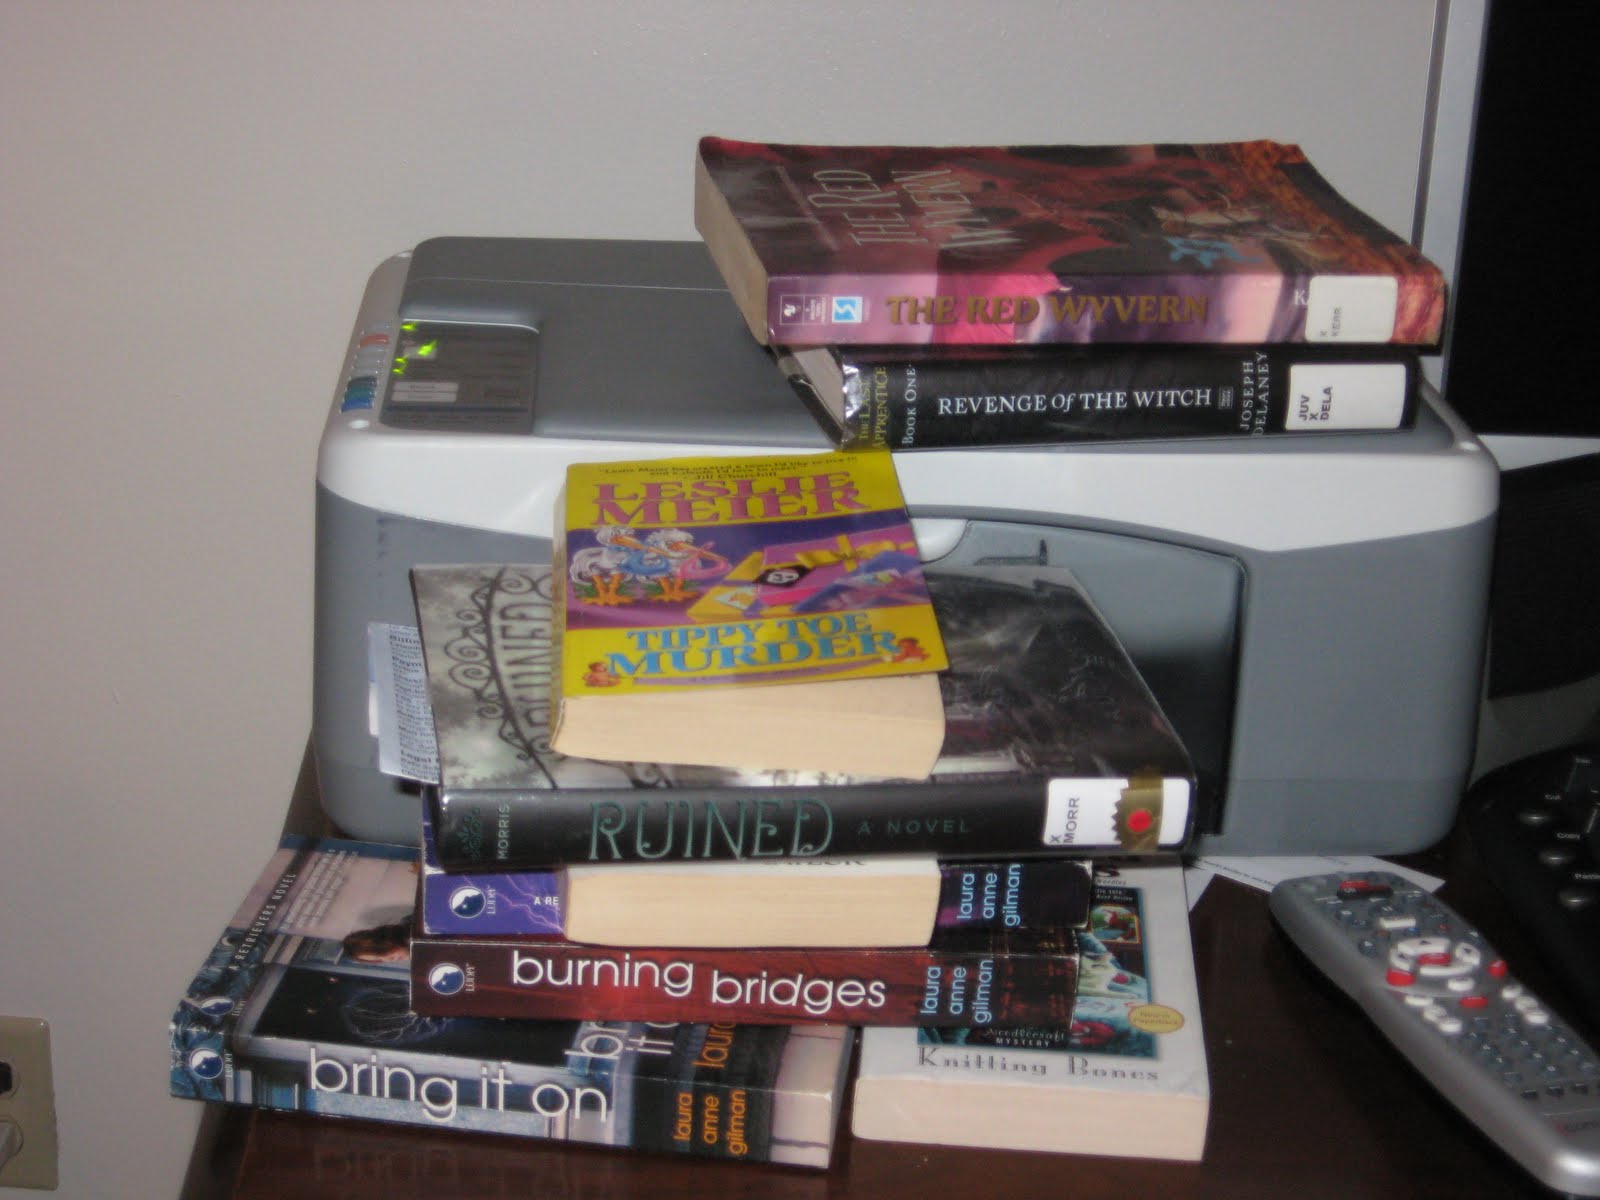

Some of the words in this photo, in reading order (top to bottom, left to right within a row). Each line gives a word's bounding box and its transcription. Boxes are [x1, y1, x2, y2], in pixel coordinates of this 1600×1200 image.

[886, 295, 956, 325] THE
[967, 295, 1041, 325] RED
[1051, 294, 1209, 325] WYVERN
[938, 394, 1047, 415] REVENGE
[1079, 391, 1127, 410] THE
[1133, 388, 1211, 409] WITCH
[1240, 361, 1254, 430] JOSEPH
[1252, 352, 1270, 436] DELANEY
[1299, 394, 1311, 420] JUV
[1310, 412, 1319, 420] X
[1320, 386, 1333, 420] DELA
[591, 488, 871, 525] MEIER
[594, 472, 855, 501] LESLIE
[608, 631, 903, 676] MURDER
[627, 622, 764, 651] TIPPY
[778, 612, 872, 639] TOE
[497, 804, 510, 860] MORRIS
[588, 799, 834, 860] RUINED
[857, 820, 872, 836] A
[887, 819, 971, 835] NOVEL
[1050, 834, 1062, 844] X
[1063, 797, 1080, 843] MORR
[957, 872, 975, 919] laura
[983, 872, 998, 919] anne
[1003, 864, 1021, 927] gilman
[512, 950, 695, 997] burning
[711, 970, 888, 1015] bridges
[920, 966, 941, 1014] laura
[950, 967, 967, 1014] anne
[973, 960, 994, 1023] gilman
[996, 1038, 1050, 1047] MYSTERY
[310, 1047, 458, 1122] bring
[481, 1066, 513, 1111] it
[531, 1083, 608, 1122] on
[1067, 1055, 1159, 1081] Bones
[673, 1092, 693, 1142] laura
[703, 1095, 720, 1145] anne
[726, 1089, 748, 1156] gilman
